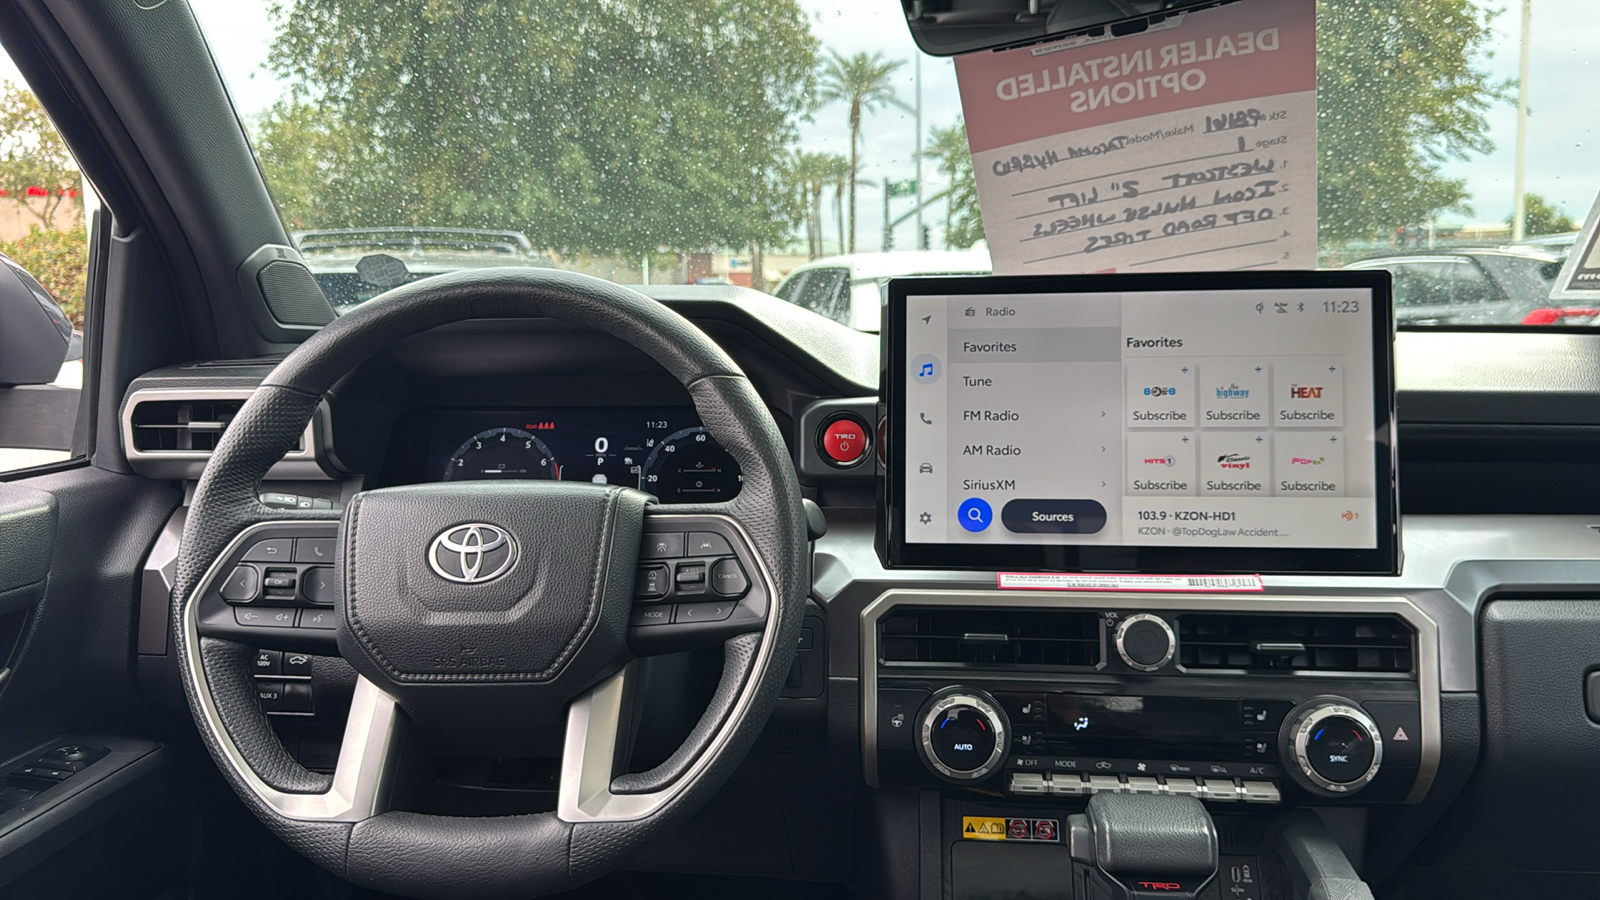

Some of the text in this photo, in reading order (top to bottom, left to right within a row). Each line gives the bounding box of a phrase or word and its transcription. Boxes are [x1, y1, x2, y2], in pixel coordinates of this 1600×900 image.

[985, 306, 1016, 317] Radio
[1322, 300, 1360, 313] 11:23
[963, 341, 1017, 353] Favorites
[1126, 336, 1183, 348] Favorites
[963, 376, 993, 387] Tune
[1216, 386, 1250, 400] highway
[1291, 387, 1323, 399] HEAT
[963, 410, 1020, 421] FM Radio
[1133, 410, 1187, 421] Subscribe
[1206, 410, 1260, 421] Subscribe
[1280, 409, 1335, 420] Subscribe
[646, 421, 668, 429] 11:23
[500, 434, 506, 442] 4
[695, 434, 706, 442] 60
[476, 441, 482, 450] 3
[525, 441, 532, 449] 5
[594, 437, 609, 453] 0
[664, 445, 676, 453] 40
[963, 444, 1021, 456] AM Radio
[457, 458, 464, 467] 2
[540, 458, 547, 466] 6
[597, 458, 604, 466] P
[1221, 462, 1250, 470] vinyl
[963, 479, 1016, 491] SiriusXM
[1133, 480, 1188, 491] Subscribe
[1206, 480, 1261, 491] Subscribe
[1281, 481, 1336, 491] Subscribe
[1032, 511, 1074, 522] Sources
[1138, 511, 1236, 521] 103.9 KZON-HD1
[1138, 526, 1166, 536] KZON
[1172, 527, 1237, 538] @TopDogLaw
[954, 743, 973, 751] AUTO
[1054, 760, 1077, 768] MODE
[1329, 755, 1349, 763] SYNC
[1249, 766, 1265, 774] A/C
[1138, 881, 1181, 890] TRD
